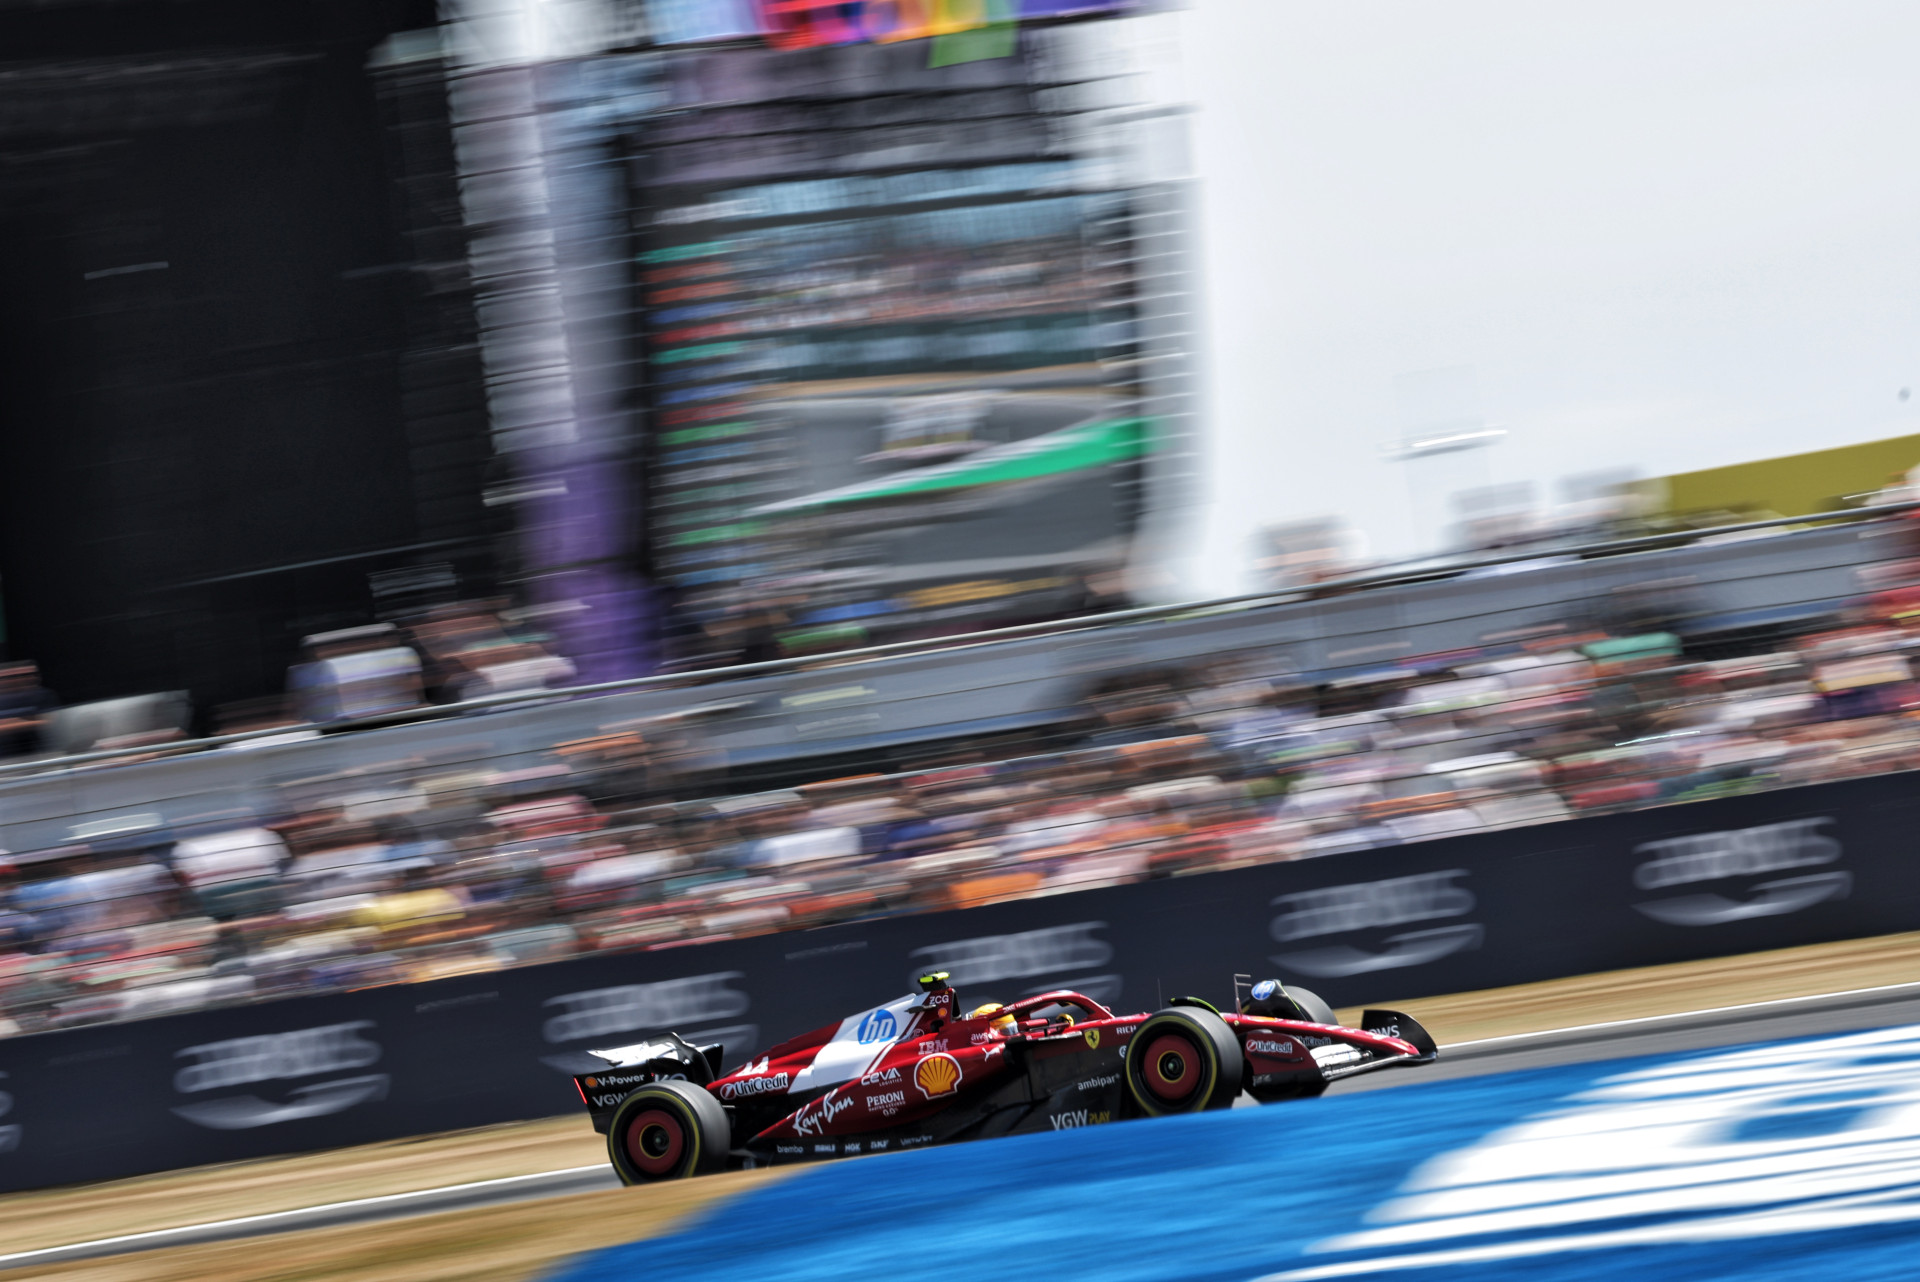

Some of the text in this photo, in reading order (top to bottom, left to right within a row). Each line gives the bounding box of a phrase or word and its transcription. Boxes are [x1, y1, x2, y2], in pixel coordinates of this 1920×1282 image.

[861, 1012, 894, 1043] hp
[918, 1039, 949, 1055] IBM
[1257, 1041, 1293, 1053] UniCredit
[597, 1074, 645, 1087] V-Power
[735, 1072, 788, 1096] UniCredit
[866, 1090, 905, 1108] PERONI
[1050, 1109, 1110, 1131] VGW PLAY
